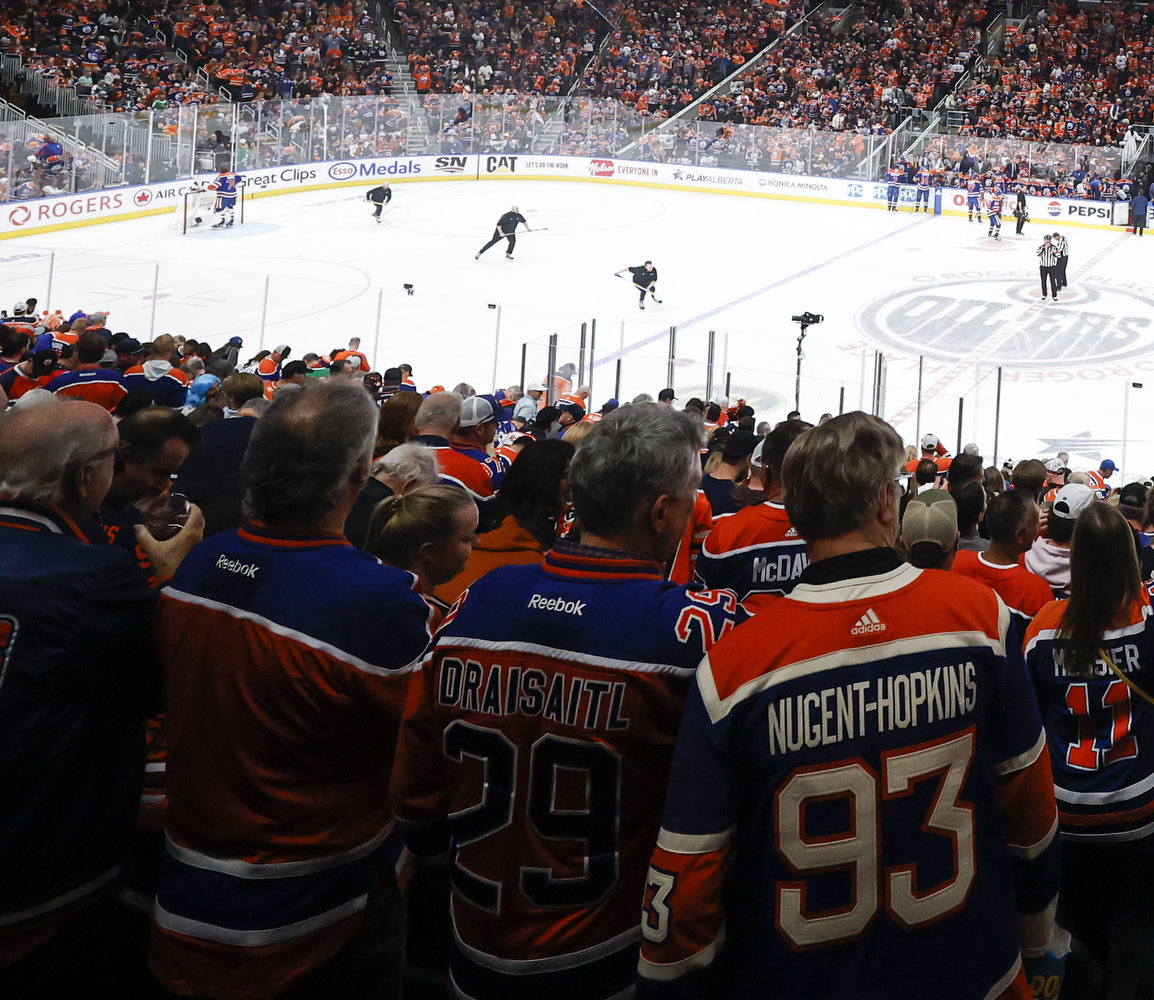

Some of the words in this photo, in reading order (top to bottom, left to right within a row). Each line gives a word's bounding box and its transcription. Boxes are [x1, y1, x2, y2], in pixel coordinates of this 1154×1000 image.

[333, 167, 353, 175] Esso
[360, 161, 421, 176] Medals
[435, 157, 467, 168] SN
[487, 157, 518, 173] CAT
[617, 166, 650, 176] EVERYONE
[237, 173, 276, 188] Great
[281, 169, 317, 183] Clips
[768, 180, 795, 188] KONICA
[797, 182, 828, 191] MINOLTA
[155, 189, 176, 200] AIR
[848, 184, 863, 197] PPG
[901, 189, 916, 202] PPG
[38, 194, 123, 220] ROGERS
[1068, 205, 1110, 219] PEPSI
[886, 296, 1152, 359] OILERS
[216, 554, 260, 579] Reebok
[528, 594, 586, 616] Reebok
[850, 621, 886, 636] adidas
[438, 657, 630, 731] DRAISAITL
[768, 661, 977, 756] NUGENT-HOPKINS
[1065, 679, 1138, 771] 11
[443, 718, 622, 916] 29
[775, 724, 977, 952] 93
[641, 867, 677, 943] 3
